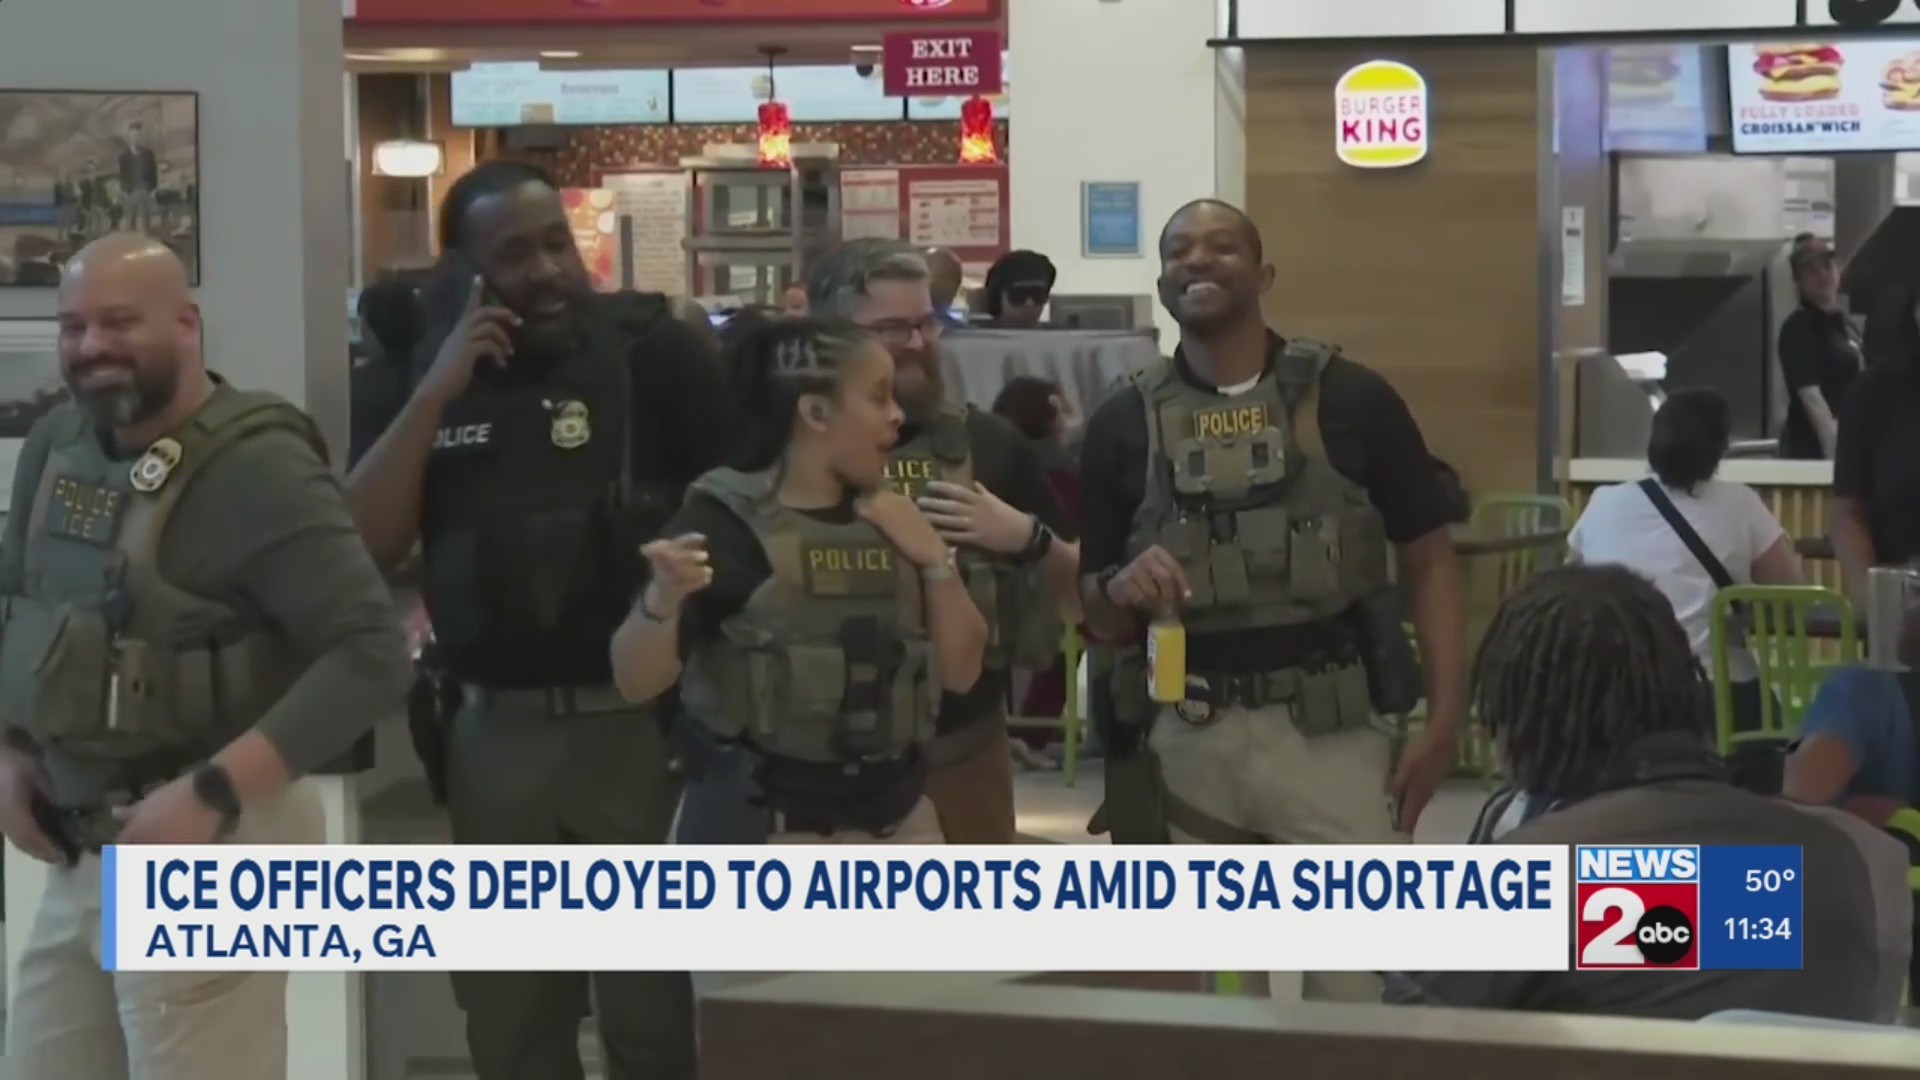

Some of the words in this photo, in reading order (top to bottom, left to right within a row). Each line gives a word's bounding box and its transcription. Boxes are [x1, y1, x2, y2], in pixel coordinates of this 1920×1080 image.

[911, 38, 972, 58] EXIT
[906, 66, 979, 86] HERE
[1341, 95, 1421, 115] BURGER
[1741, 105, 1788, 119] FULLY
[1795, 103, 1860, 118] LOADED
[1342, 117, 1421, 143] KING
[1199, 407, 1263, 437] POLICE
[433, 423, 491, 448] OLICE
[884, 459, 934, 479] LICE
[55, 478, 119, 517] POLICE
[61, 512, 95, 538] ICE
[809, 549, 893, 571] POLICE
